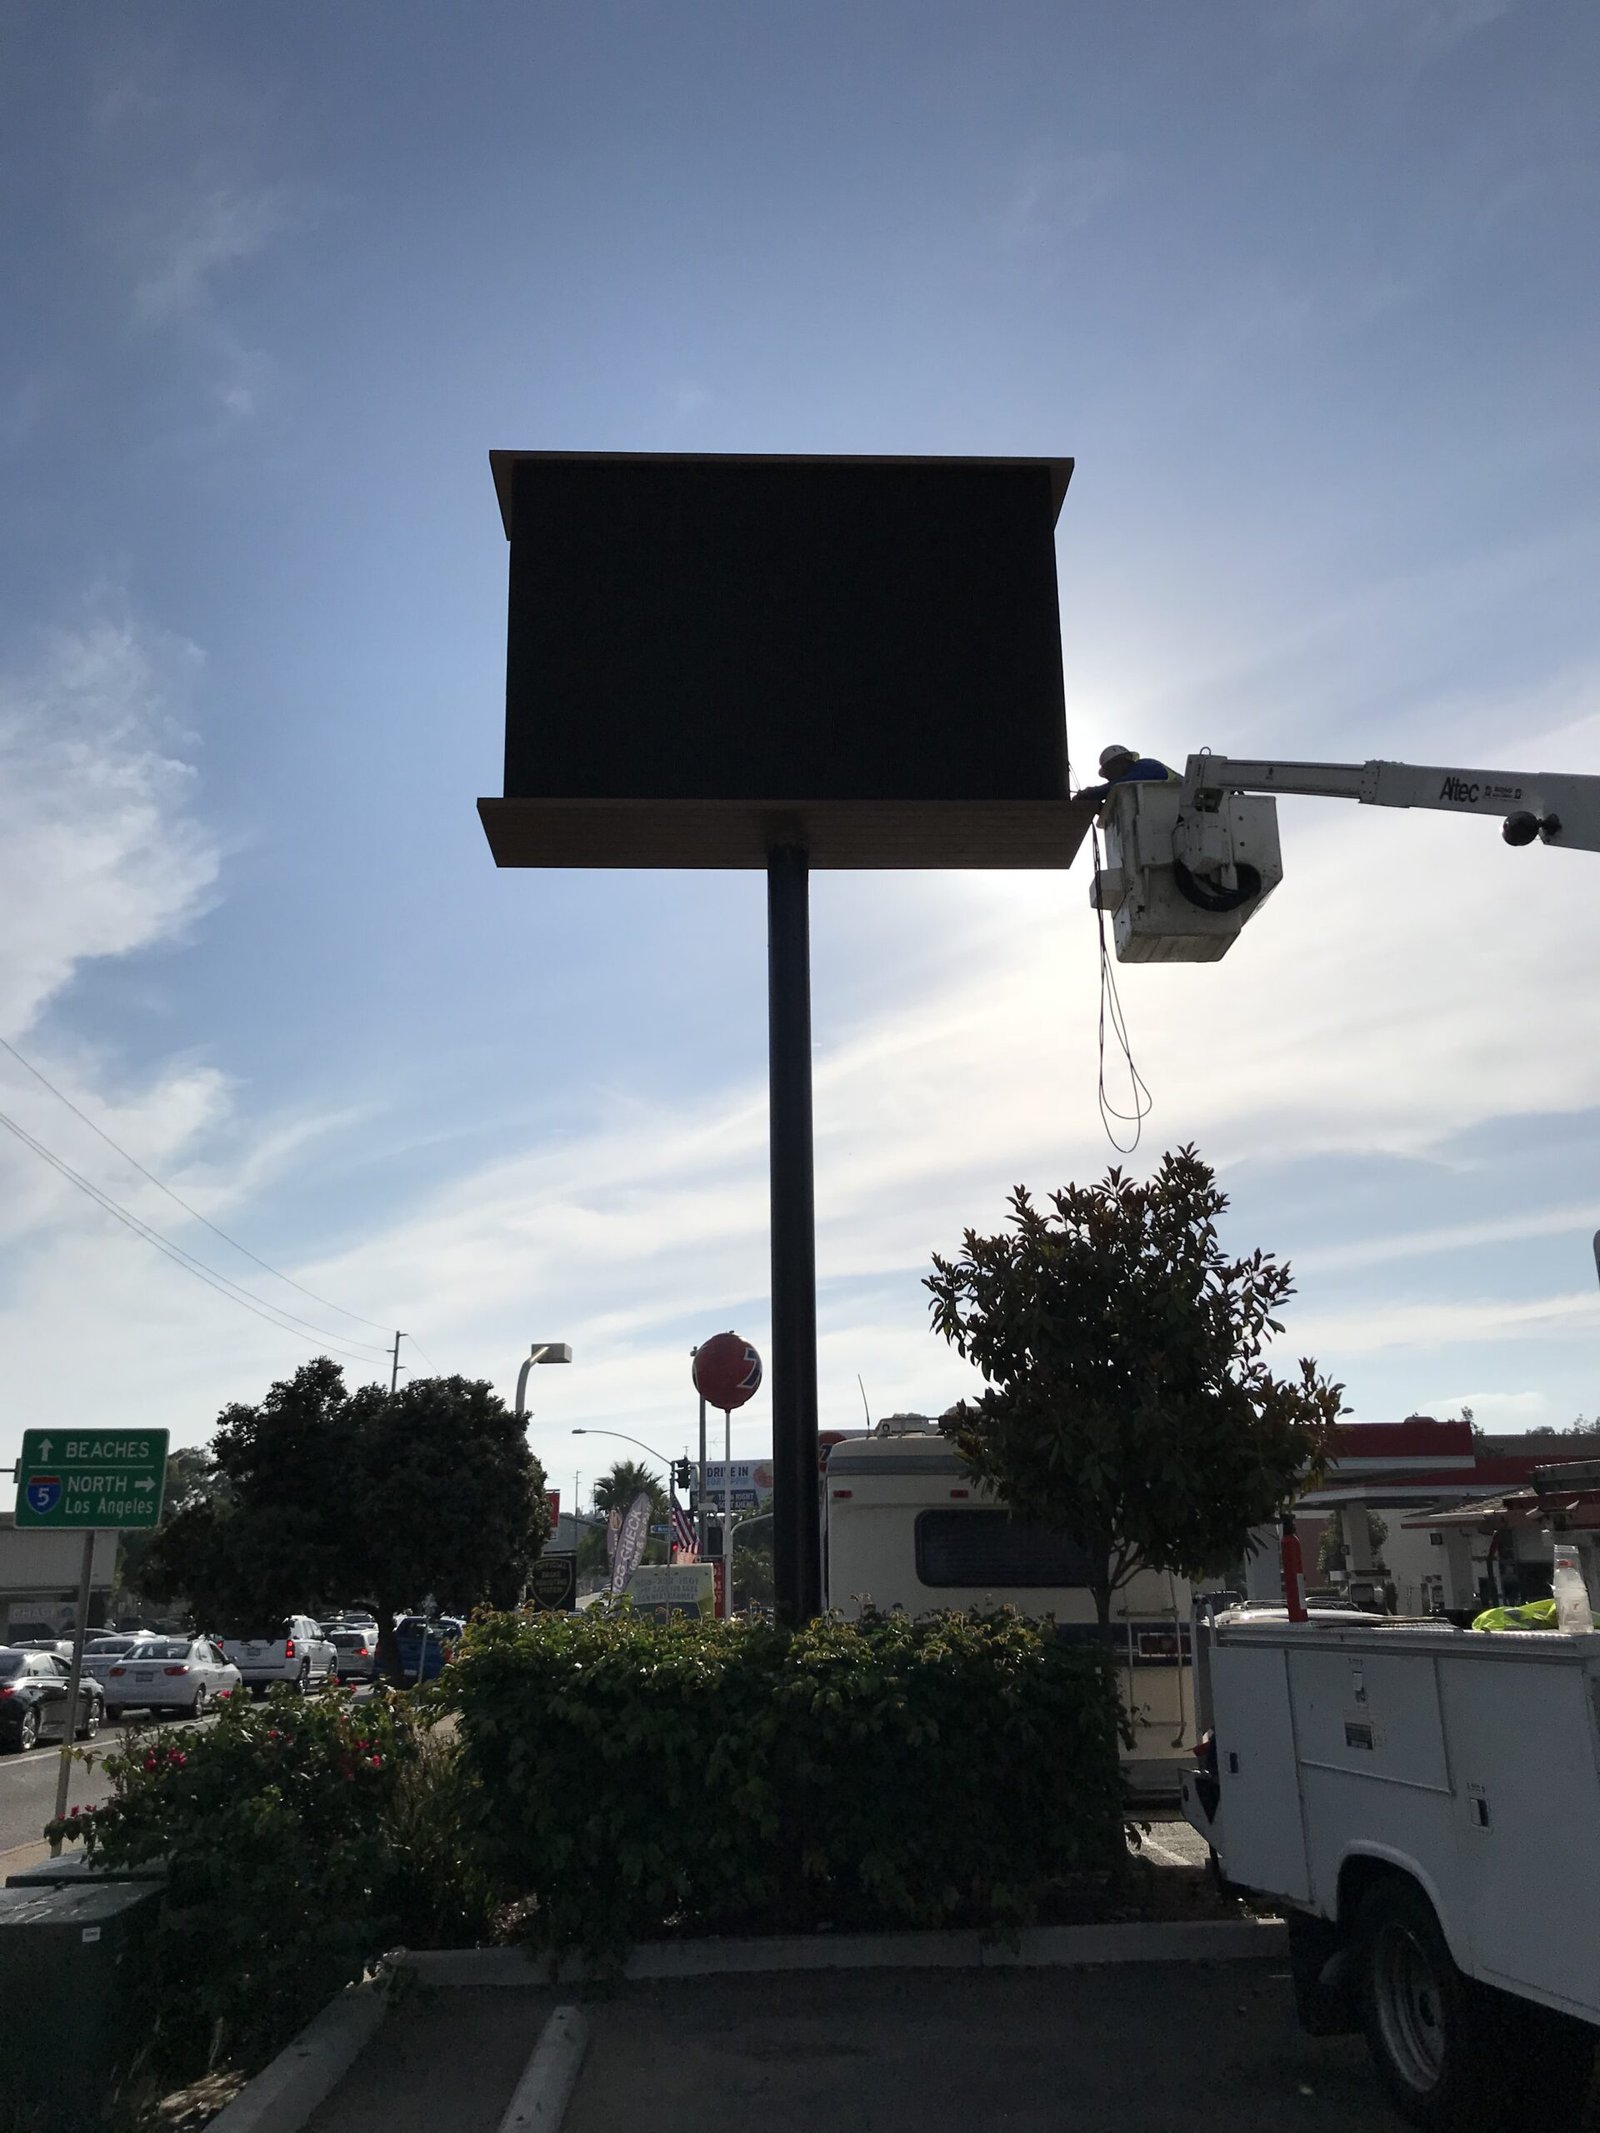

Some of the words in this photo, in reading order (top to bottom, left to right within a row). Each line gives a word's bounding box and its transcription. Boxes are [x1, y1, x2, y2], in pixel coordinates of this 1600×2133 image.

[1440, 776, 1480, 803] Altec
[66, 1442, 150, 1458] BEACHES
[707, 1467, 736, 1477] DRIE
[738, 1466, 749, 1476] IN
[67, 1476, 128, 1492] NORTH
[36, 1487, 50, 1506] 5
[65, 1498, 90, 1514] Los
[97, 1497, 153, 1518] Angeles
[621, 1510, 641, 1561] CHECK
